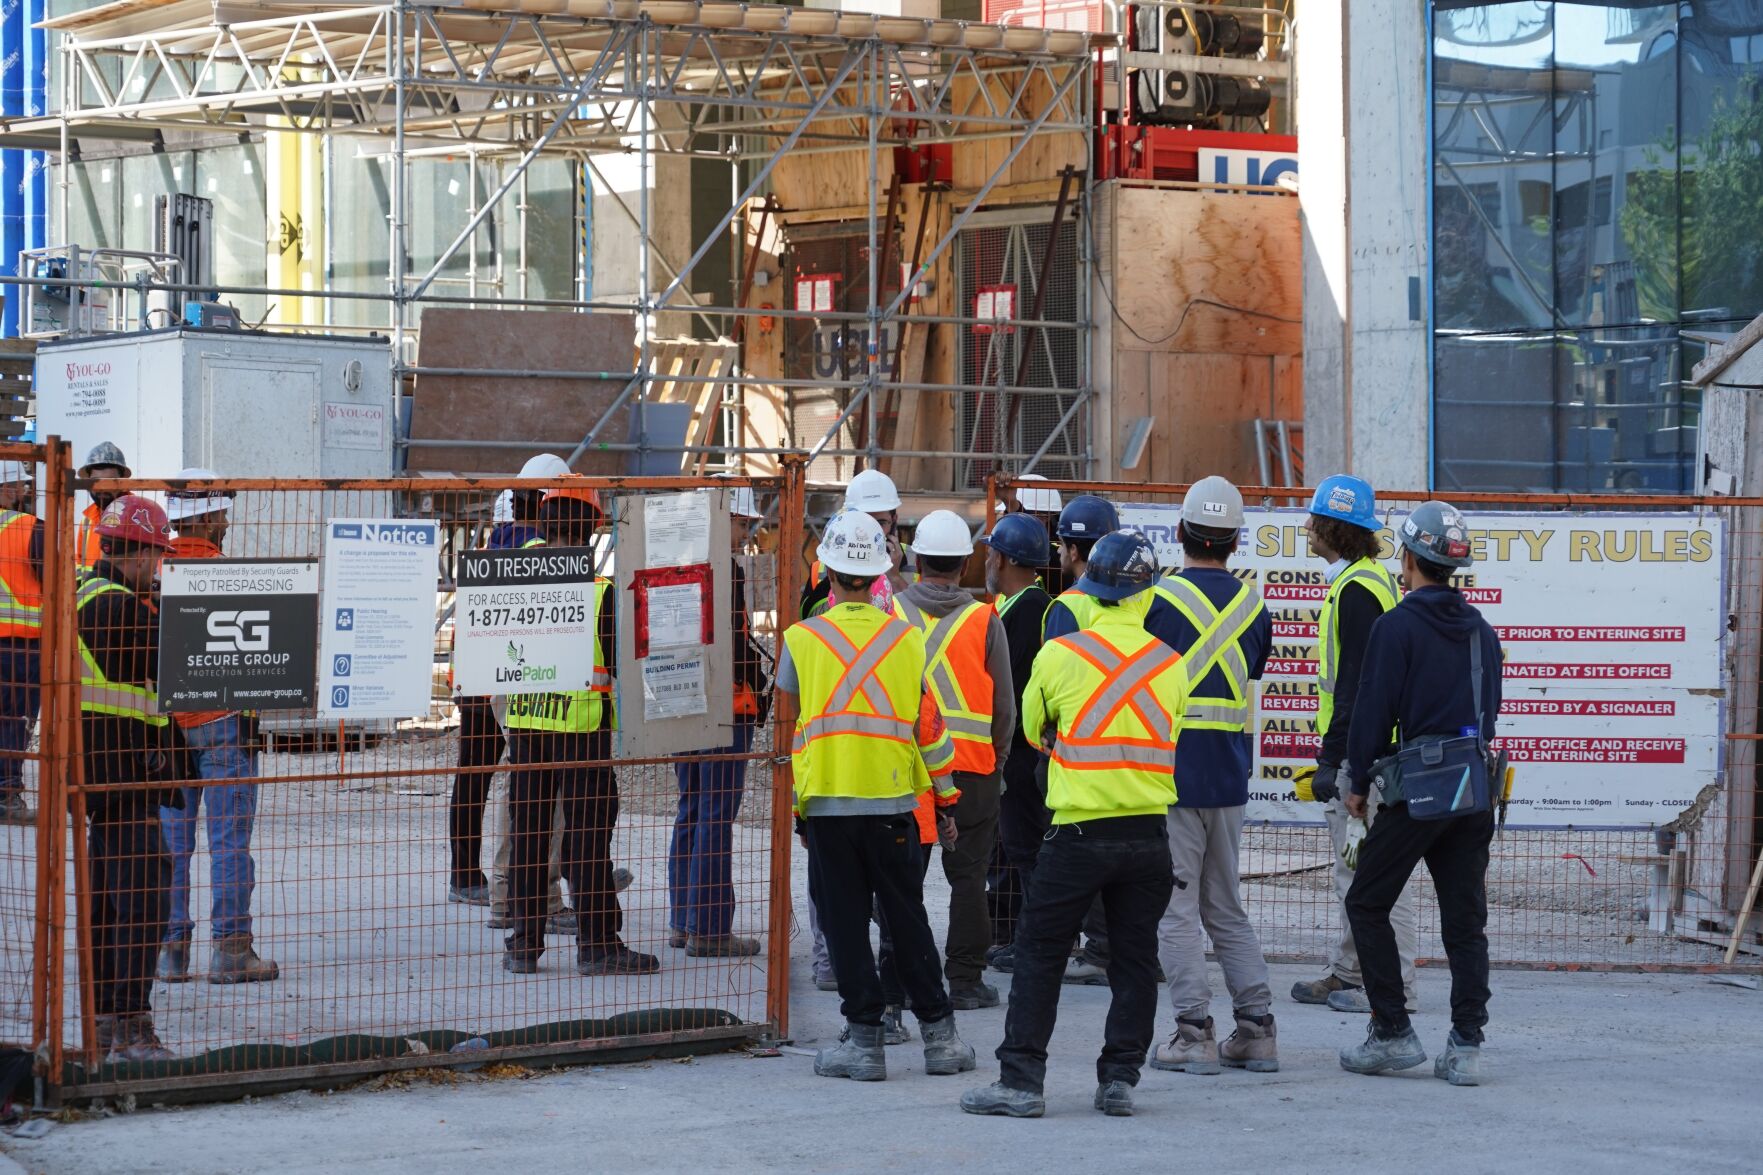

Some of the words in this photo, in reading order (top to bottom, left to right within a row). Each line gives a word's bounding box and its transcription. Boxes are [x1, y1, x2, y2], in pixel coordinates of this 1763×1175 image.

[77, 363, 111, 377] YOU-GO
[362, 524, 427, 545] Notice
[1570, 529, 1713, 562] RULES
[183, 568, 211, 578] Property
[212, 567, 240, 576] Patrolled
[242, 567, 250, 577] By
[250, 566, 275, 577] Security
[277, 566, 299, 575] Guards
[466, 559, 490, 579] NO
[495, 555, 589, 578] TRESPASSING
[188, 580, 207, 592] NO
[210, 578, 294, 592] TRESPASSING
[468, 594, 488, 606] FOR
[490, 592, 528, 606] ACCESS,
[531, 591, 562, 604] PLEASE
[564, 590, 584, 602] CALL
[468, 605, 585, 627] 1-877-497-0125
[206, 610, 270, 652] SG
[467, 629, 508, 638] UNAUTHORIZED
[510, 628, 533, 636] PERSONS
[1509, 628, 1552, 638] PRIOR
[1555, 628, 1574, 639] TO
[1578, 628, 1650, 639] ENTERING
[1652, 629, 1682, 639] SITE
[1269, 646, 1312, 658] ANY
[187, 654, 239, 667] SECURE
[244, 653, 290, 665] GROUP
[188, 668, 242, 677] PROTECTION
[247, 668, 286, 676] SERVICES
[496, 665, 556, 682] LivePatrol
[645, 664, 675, 674] BUILDING
[676, 661, 700, 670] PERMIT
[1264, 662, 1300, 672] PAST
[1560, 667, 1580, 676] AT
[1584, 667, 1614, 677] SITE
[1618, 667, 1668, 677] OFFICE
[172, 690, 217, 700] 416-751-1894
[234, 689, 302, 698] www.secure-group.ca
[1265, 683, 1302, 694] ALL
[508, 692, 573, 721] ECURITY
[1562, 703, 1582, 713] BY
[1586, 704, 1598, 713] A
[1601, 704, 1672, 714] SIGNALER
[1264, 720, 1300, 732] ALL
[1264, 736, 1292, 745] ARE
[1506, 739, 1534, 749] SITE
[1540, 739, 1587, 750] OFFICE
[1590, 740, 1622, 750] AND
[1626, 740, 1682, 750] RECEIVE
[1512, 750, 1528, 760] TO
[1532, 750, 1604, 760] ENTERING
[1608, 751, 1638, 761] SITE
[1263, 766, 1292, 778] NO
[1572, 798, 1581, 806] to
[1584, 799, 1612, 807] 1:00pm
[1626, 799, 1654, 807] Sunday
